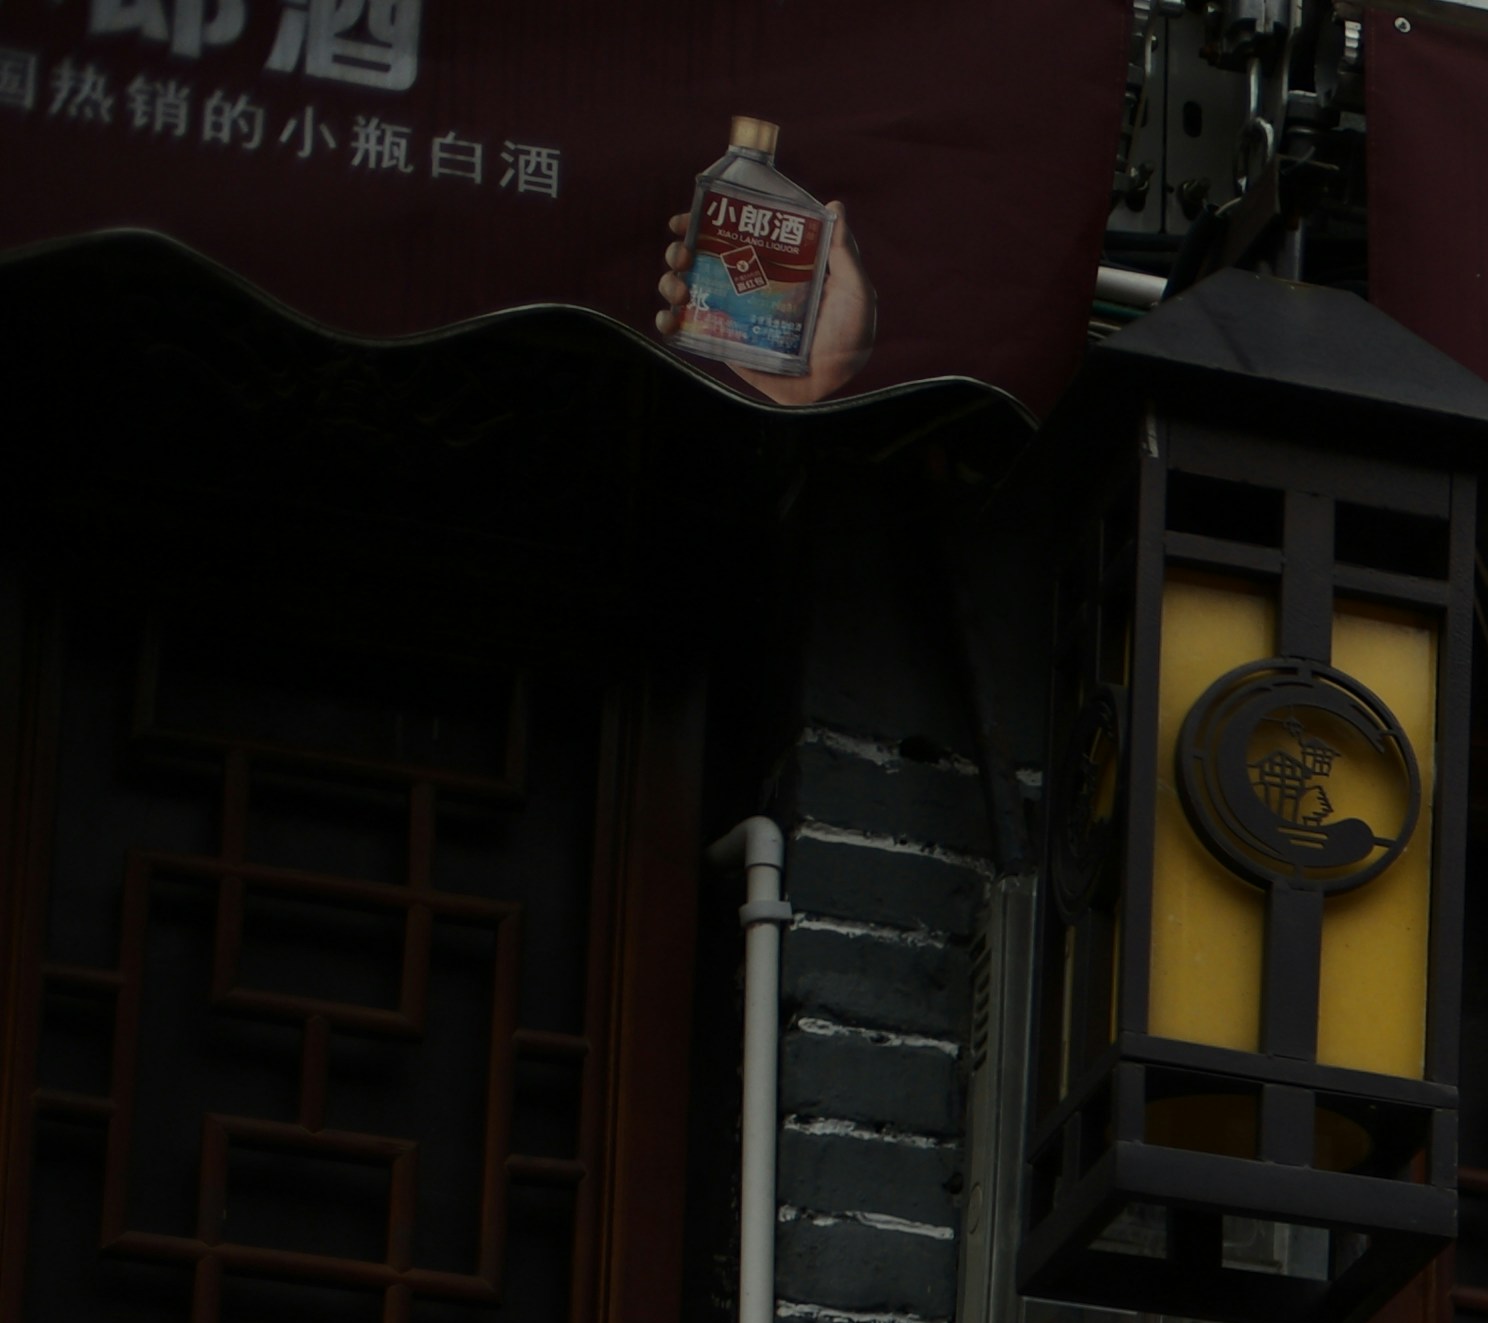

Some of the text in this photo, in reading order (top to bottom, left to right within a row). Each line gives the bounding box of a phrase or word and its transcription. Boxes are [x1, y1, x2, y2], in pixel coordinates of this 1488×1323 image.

[706, 197, 806, 246] 小郎酒
[716, 229, 801, 256] XIAO LANG LIQUOR
